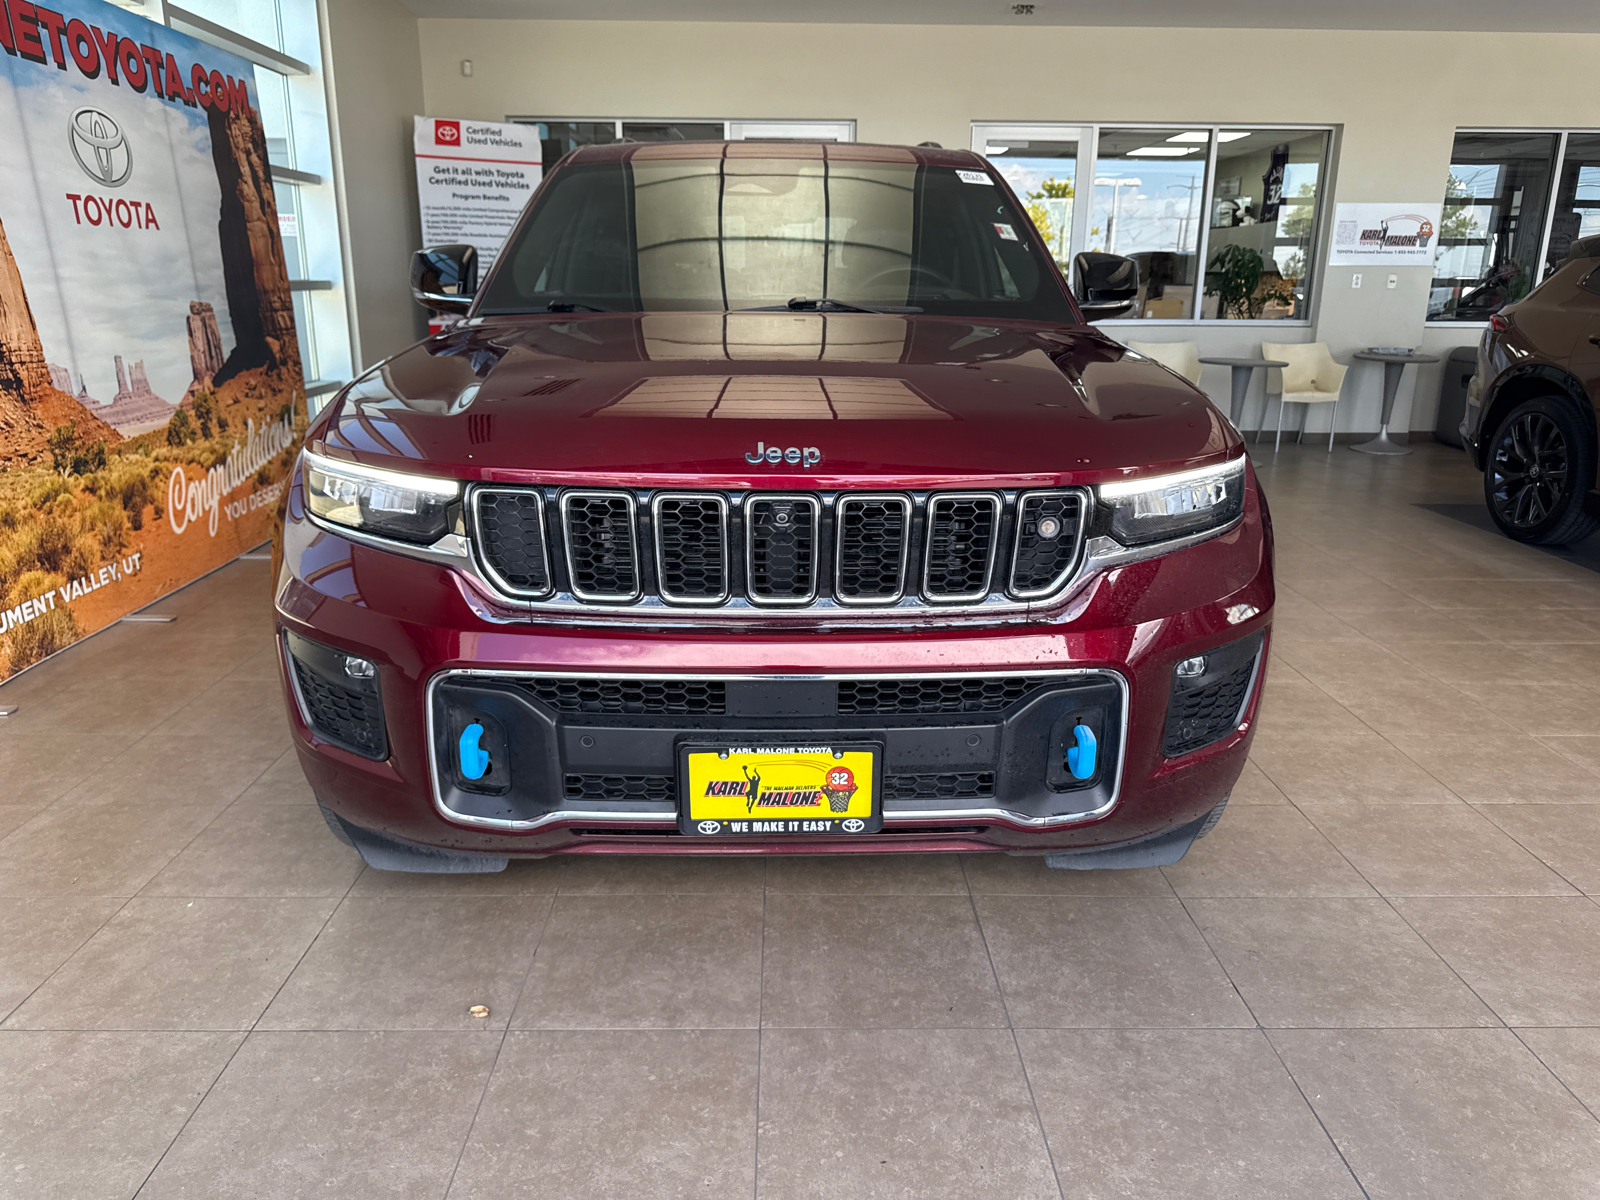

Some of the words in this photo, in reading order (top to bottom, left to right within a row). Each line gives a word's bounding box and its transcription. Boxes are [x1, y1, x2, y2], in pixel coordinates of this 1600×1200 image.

[466, 126, 502, 136] Certified
[466, 136, 488, 146] Used
[489, 138, 523, 148] Vehicles
[433, 166, 451, 175] Get
[452, 166, 459, 175] it
[460, 167, 473, 176] all
[474, 168, 494, 177] with
[496, 169, 525, 180] Toyota
[429, 177, 469, 187] Certified
[470, 178, 493, 188] Used
[494, 180, 530, 190] Vehicles
[452, 192, 481, 201] Program
[66, 193, 160, 231] TOYOTA
[1421, 224, 1431, 233] 32
[1384, 235, 1418, 247] MALONE
[745, 441, 821, 468] Jeep
[224, 498, 248, 521] YOU
[59, 562, 122, 604] VALLEY,
[122, 553, 142, 576] UT
[756, 747, 795, 755] MALONE
[797, 747, 833, 755] TOYOTA
[831, 772, 849, 785] 32
[704, 780, 749, 797] KARL
[756, 791, 823, 807] MALONE
[731, 822, 749, 832] WE
[752, 821, 785, 832] MAKE
[788, 821, 799, 832] IT
[802, 820, 832, 832] EASY
